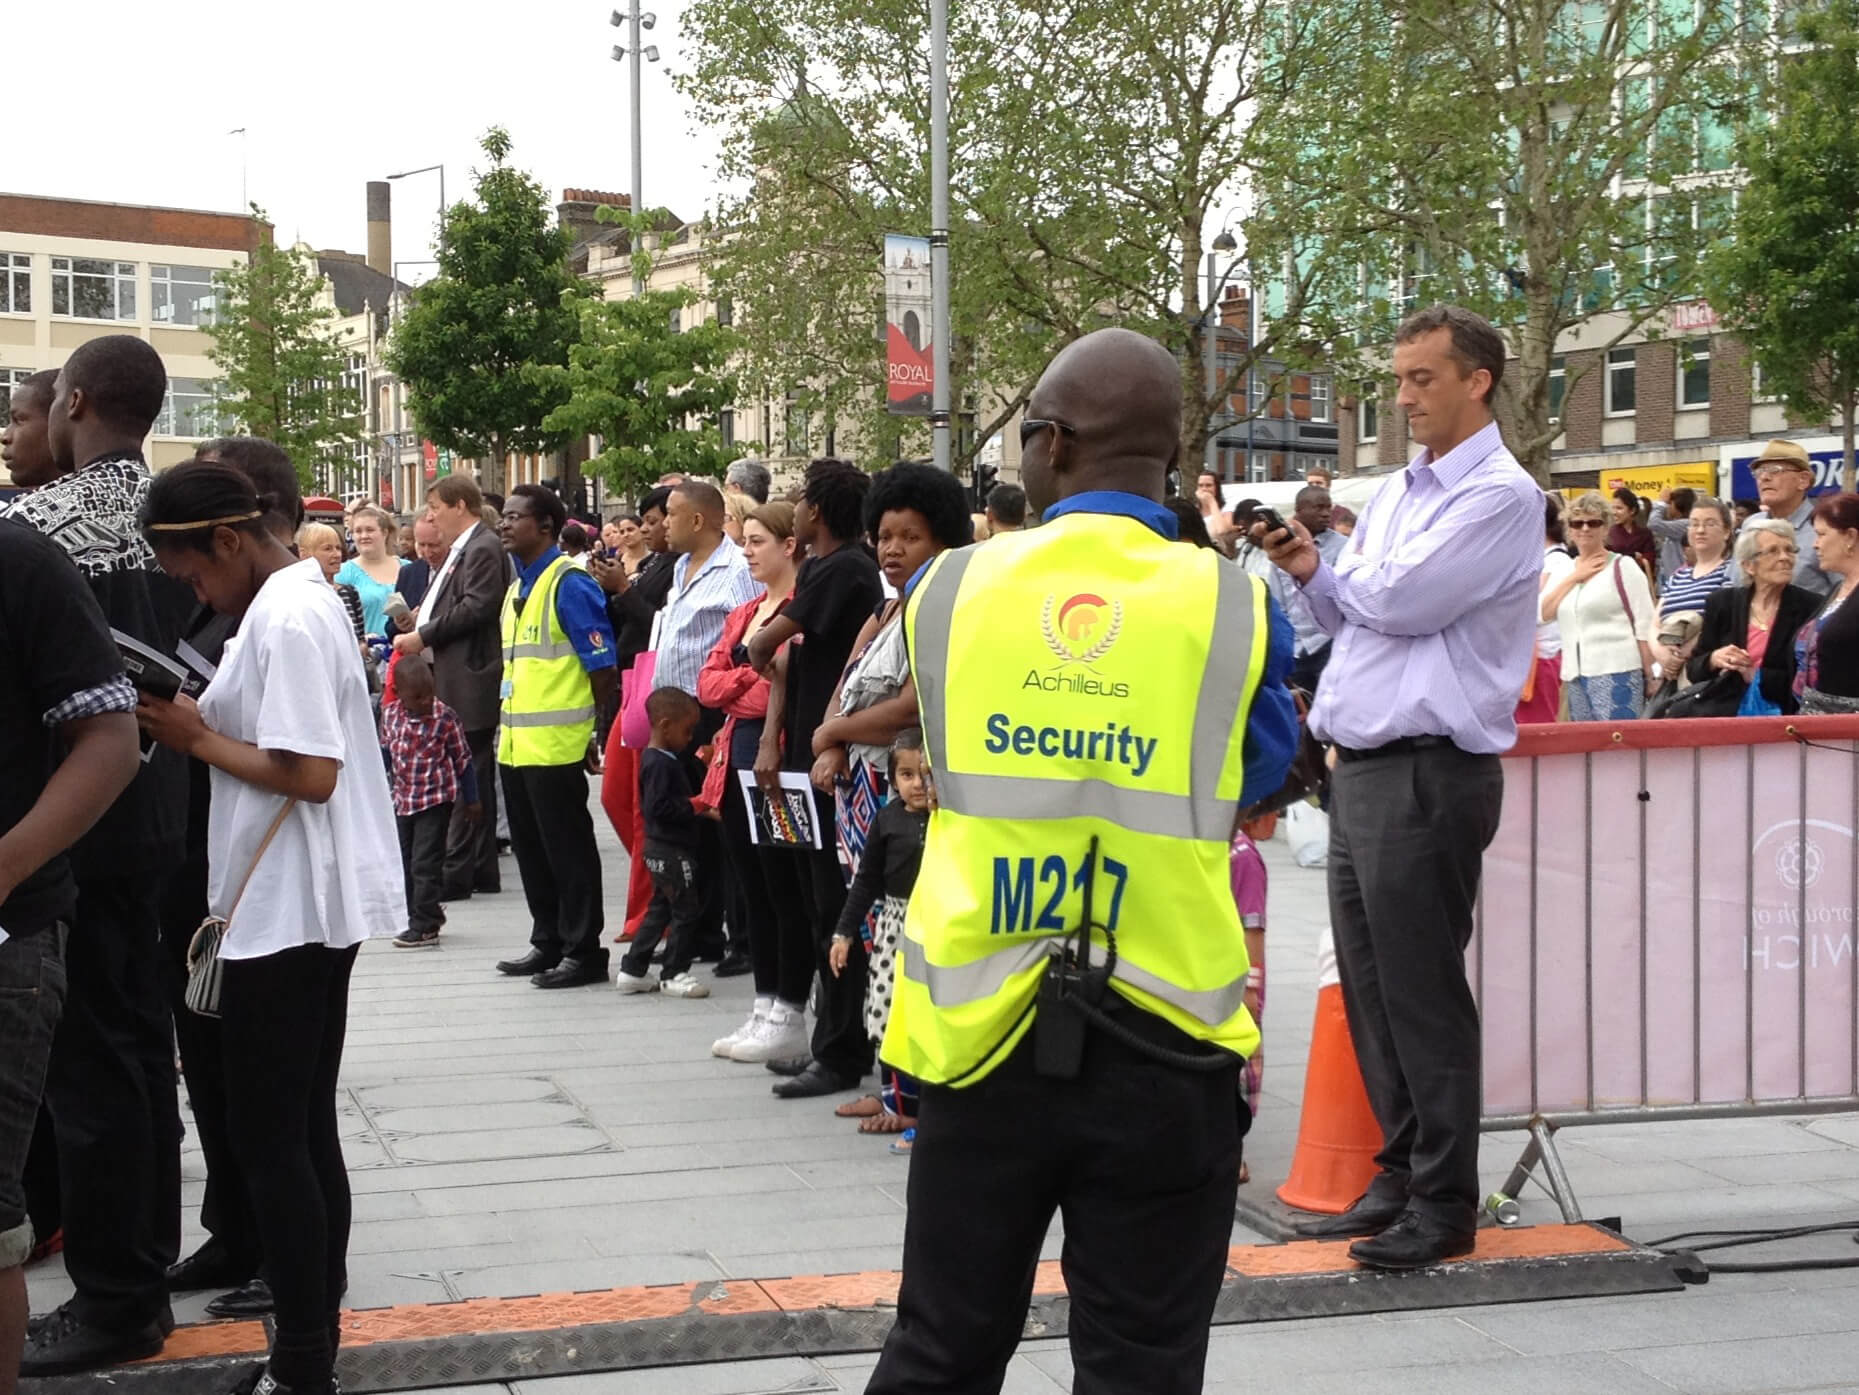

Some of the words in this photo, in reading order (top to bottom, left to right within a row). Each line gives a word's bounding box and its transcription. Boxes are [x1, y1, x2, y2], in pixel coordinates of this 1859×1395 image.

[889, 362, 933, 382] ROYAL
[1624, 479, 1664, 492] Money
[1022, 669, 1130, 698] Achilleus
[985, 713, 1159, 777] Security
